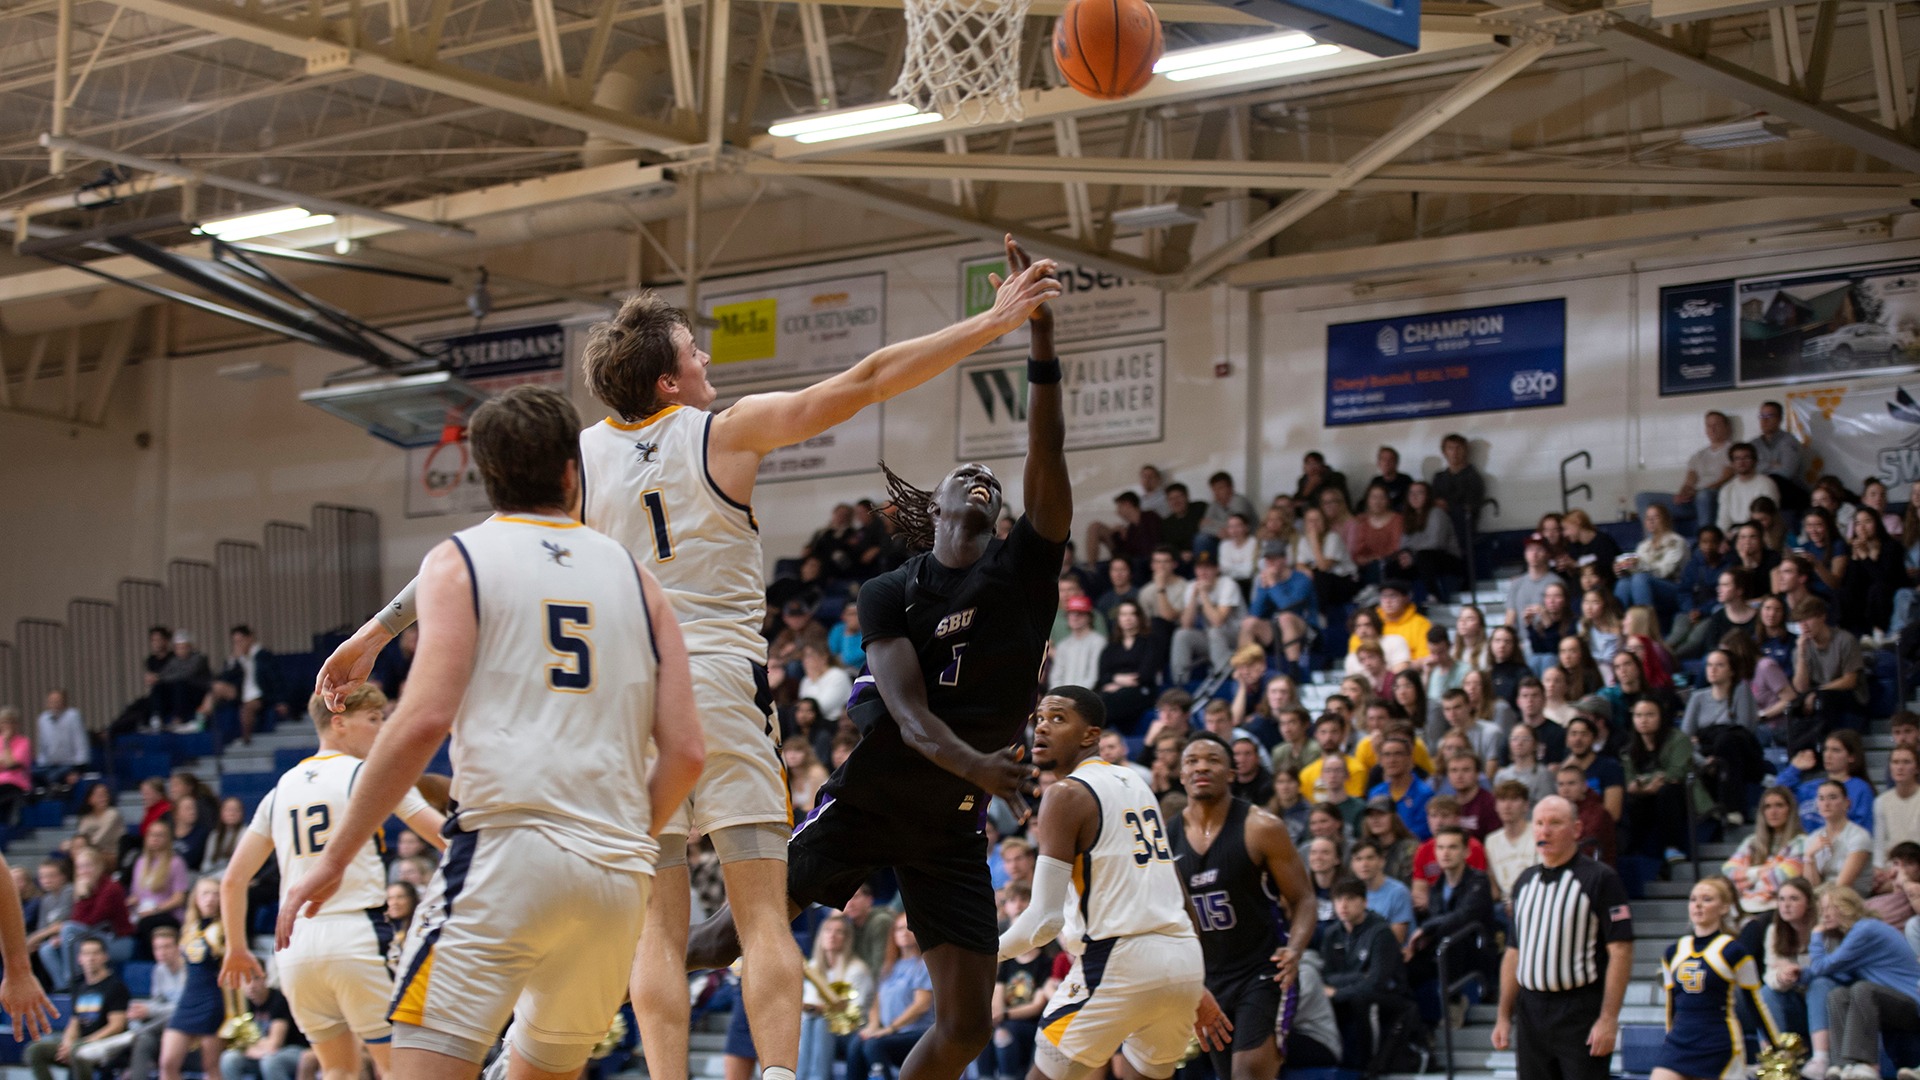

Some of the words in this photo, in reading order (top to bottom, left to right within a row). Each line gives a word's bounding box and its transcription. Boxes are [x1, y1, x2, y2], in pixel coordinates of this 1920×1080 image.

[1402, 315, 1504, 344] CHAMPION
[1069, 385, 1154, 417] TURNER
[641, 489, 675, 562] 1
[935, 607, 977, 639] SBU
[542, 600, 594, 693] 5
[939, 642, 969, 686] 1
[288, 802, 332, 857] 12
[1123, 806, 1172, 867] 32
[1190, 869, 1219, 887] SBU
[1191, 890, 1237, 931] 15
